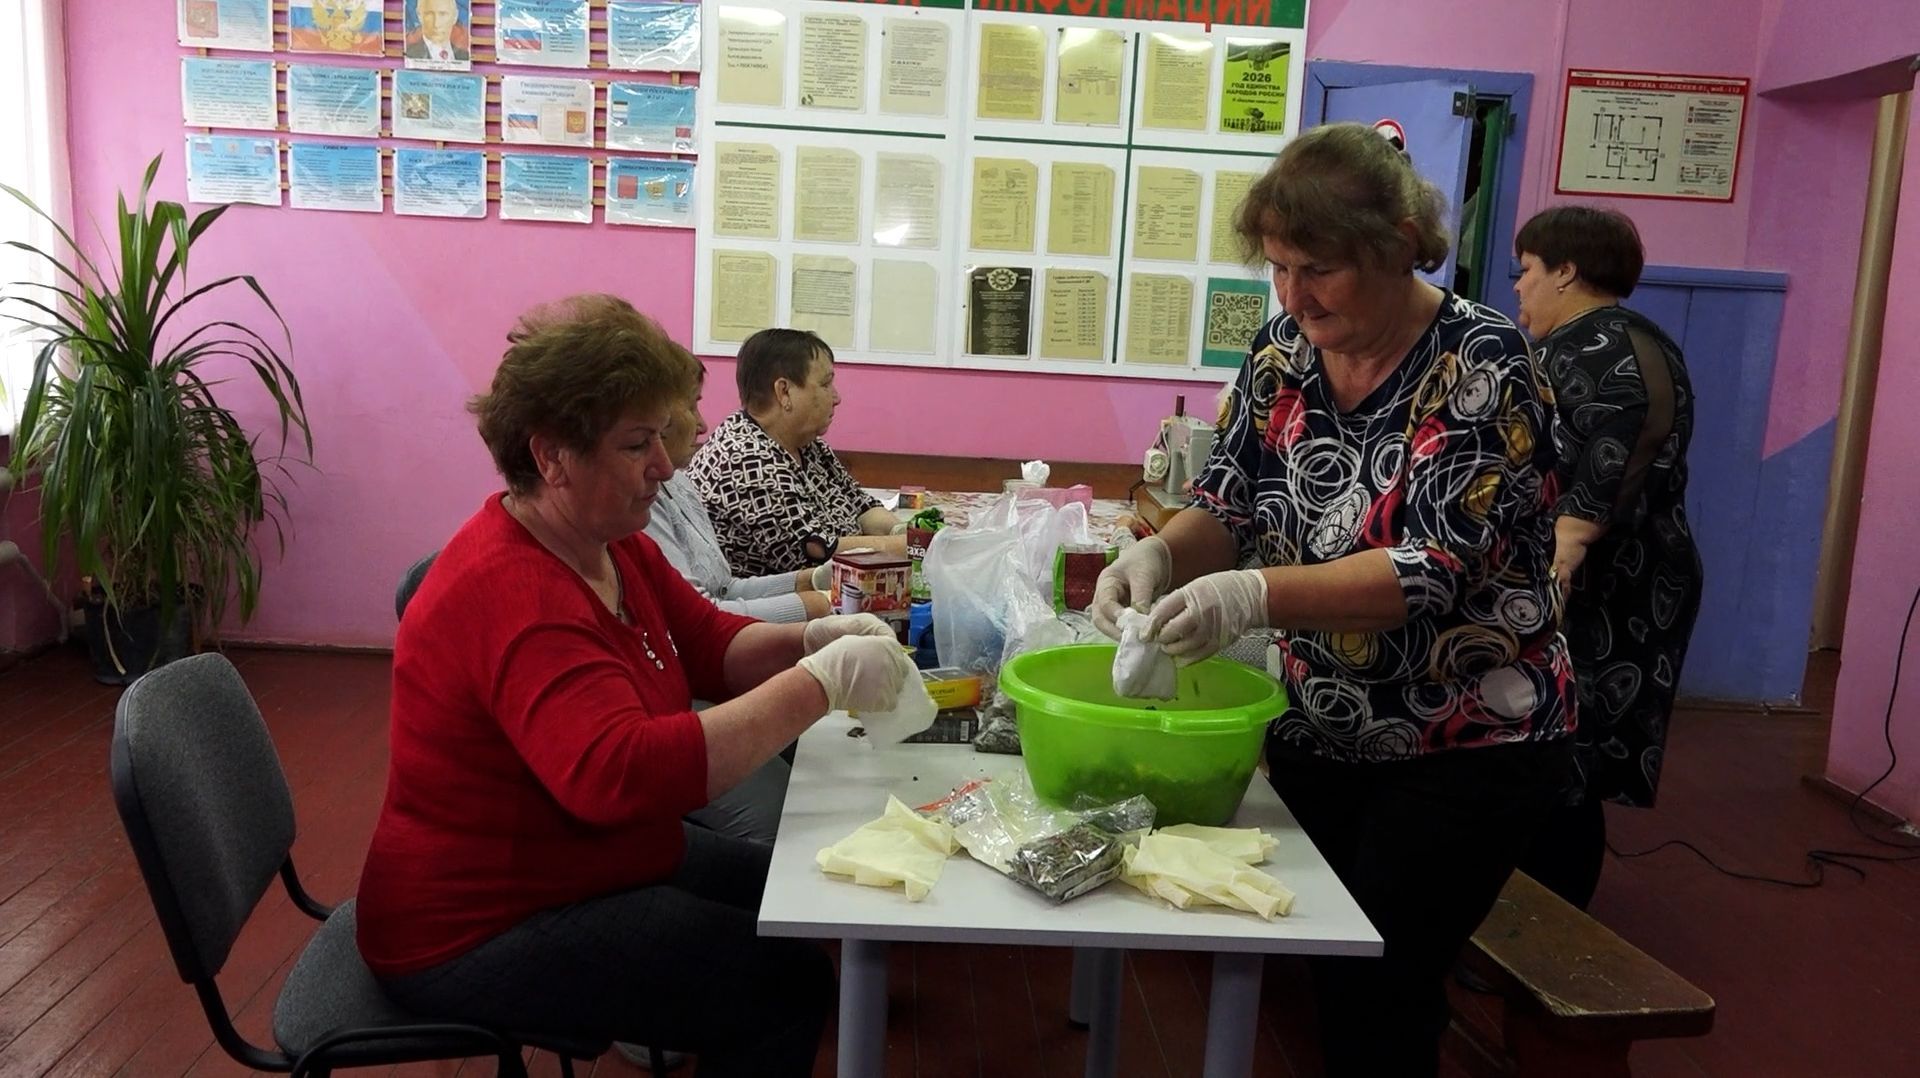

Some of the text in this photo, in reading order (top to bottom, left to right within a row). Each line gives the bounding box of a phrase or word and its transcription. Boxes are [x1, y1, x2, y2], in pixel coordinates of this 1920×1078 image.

[1242, 72, 1272, 83] 2026
[1246, 83, 1281, 91] ЕДИНСТВА
[1258, 90, 1285, 98] РОССИИ
[907, 545, 925, 557] саха
